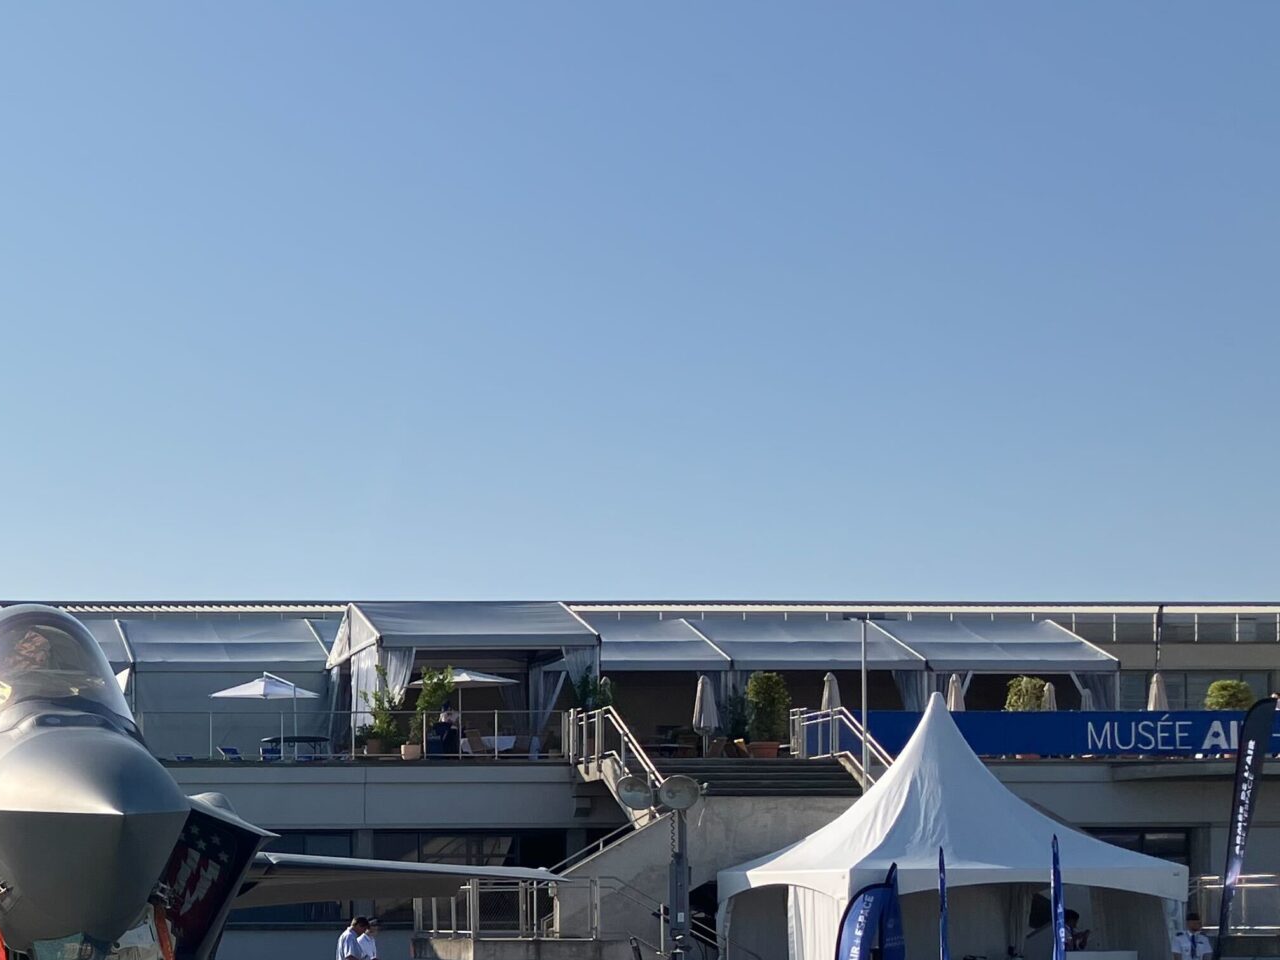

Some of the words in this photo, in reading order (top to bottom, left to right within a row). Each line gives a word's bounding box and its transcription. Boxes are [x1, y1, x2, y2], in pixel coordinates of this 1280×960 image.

[1087, 714, 1192, 750] MUSÉE
[1201, 720, 1244, 750] AI
[854, 894, 874, 936] ESPACE
